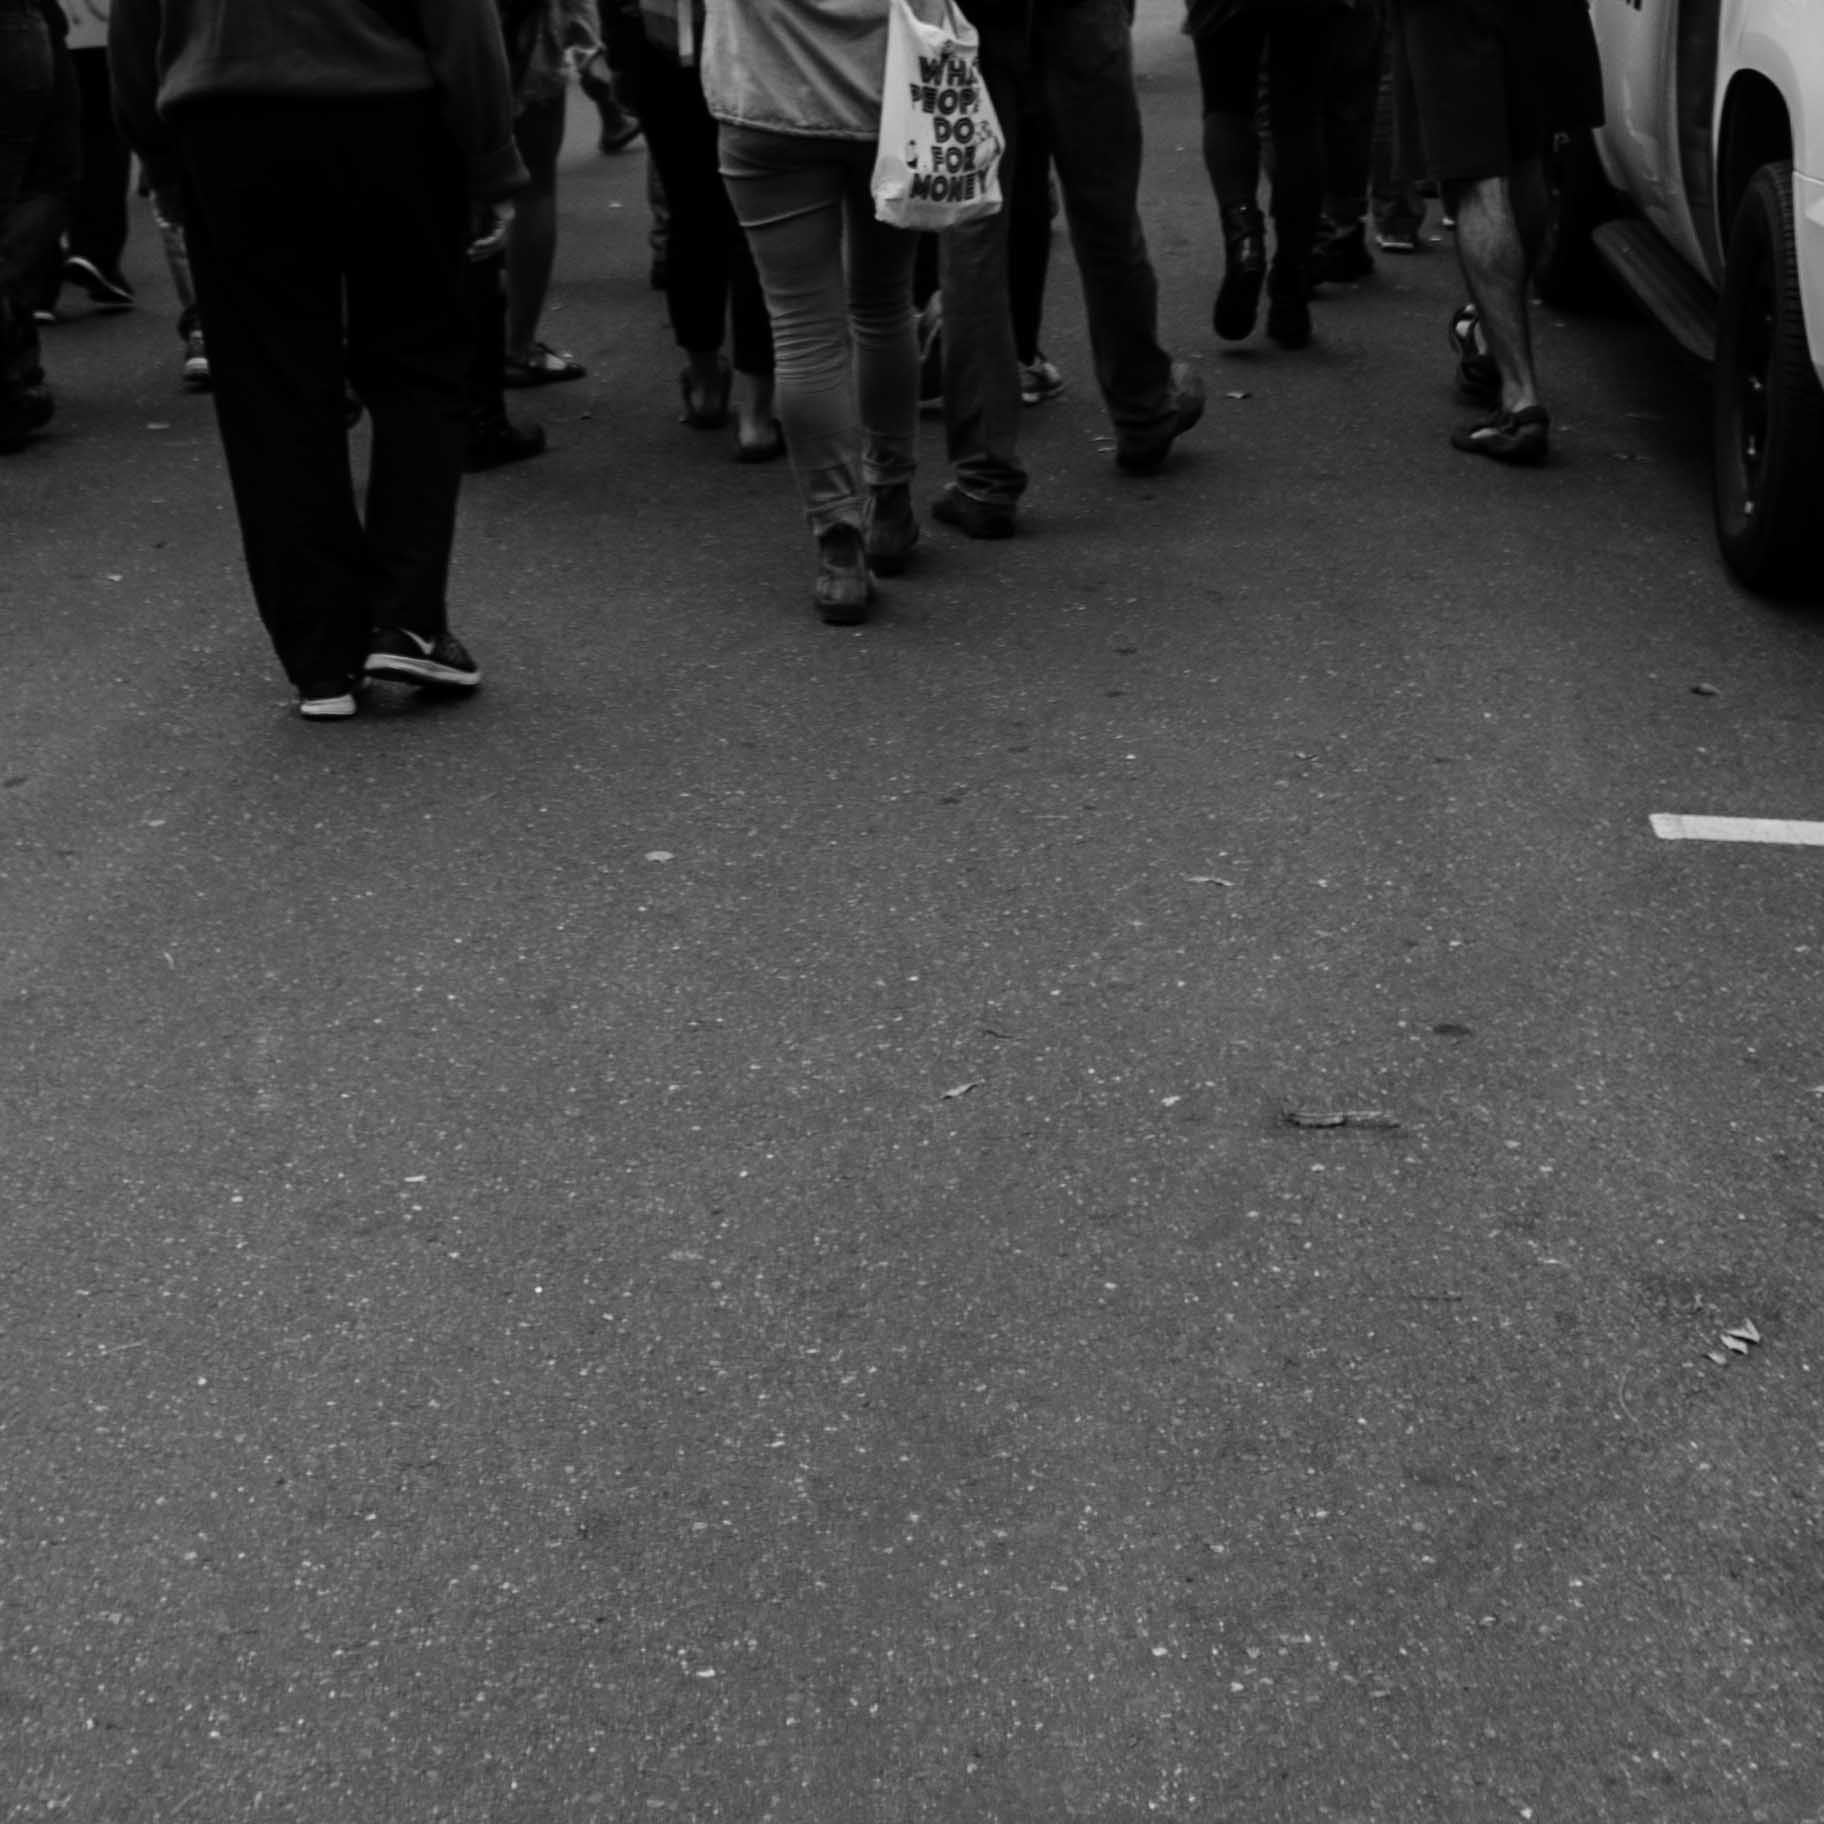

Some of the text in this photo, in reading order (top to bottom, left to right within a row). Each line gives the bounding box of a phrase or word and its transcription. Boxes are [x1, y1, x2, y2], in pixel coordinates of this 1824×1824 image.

[919, 55, 979, 85] WHA
[933, 117, 976, 144] DO
[909, 170, 989, 202] MONEY
